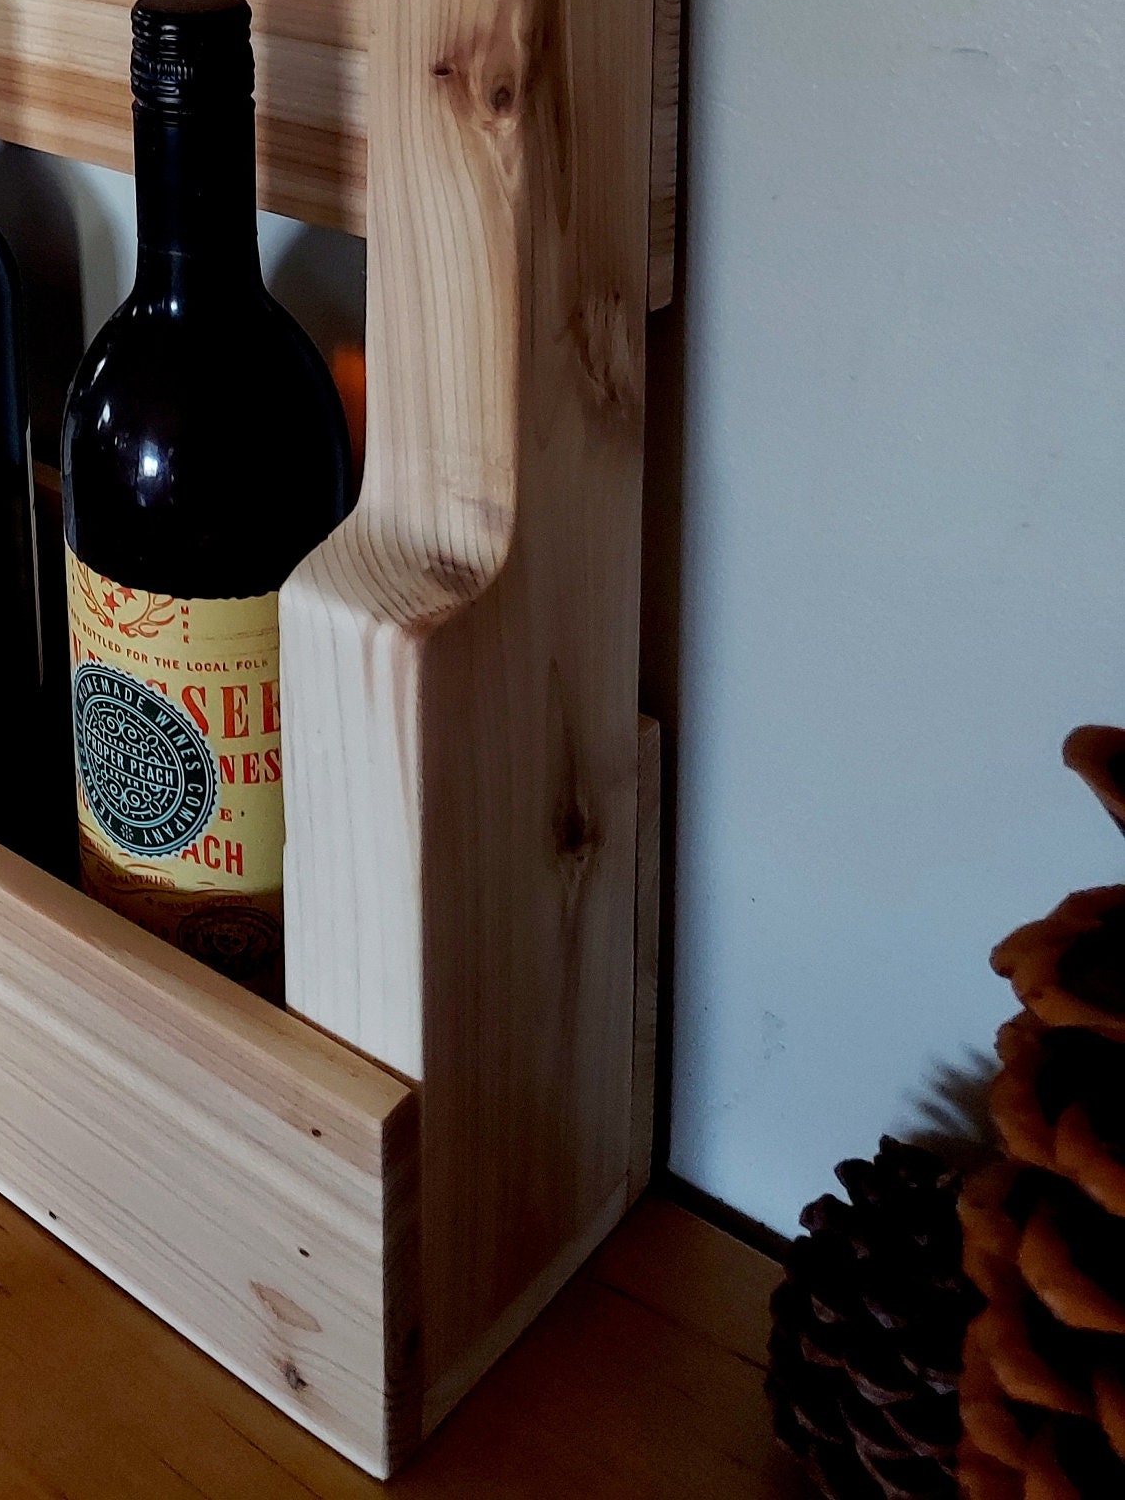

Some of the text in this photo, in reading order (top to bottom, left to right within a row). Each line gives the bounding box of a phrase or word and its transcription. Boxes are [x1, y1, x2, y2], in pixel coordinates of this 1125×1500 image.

[82, 622, 122, 654] BOTTLED
[126, 648, 148, 664] FOR
[154, 656, 180, 669] THE
[186, 661, 230, 672] LOCAL
[236, 659, 269, 671] FOLK
[78, 675, 205, 845] HOMEMADE WINES COMPANY
[86, 730, 175, 787] PROPER PEACH
[218, 747, 281, 785] NES
[181, 835, 244, 877] ACH
